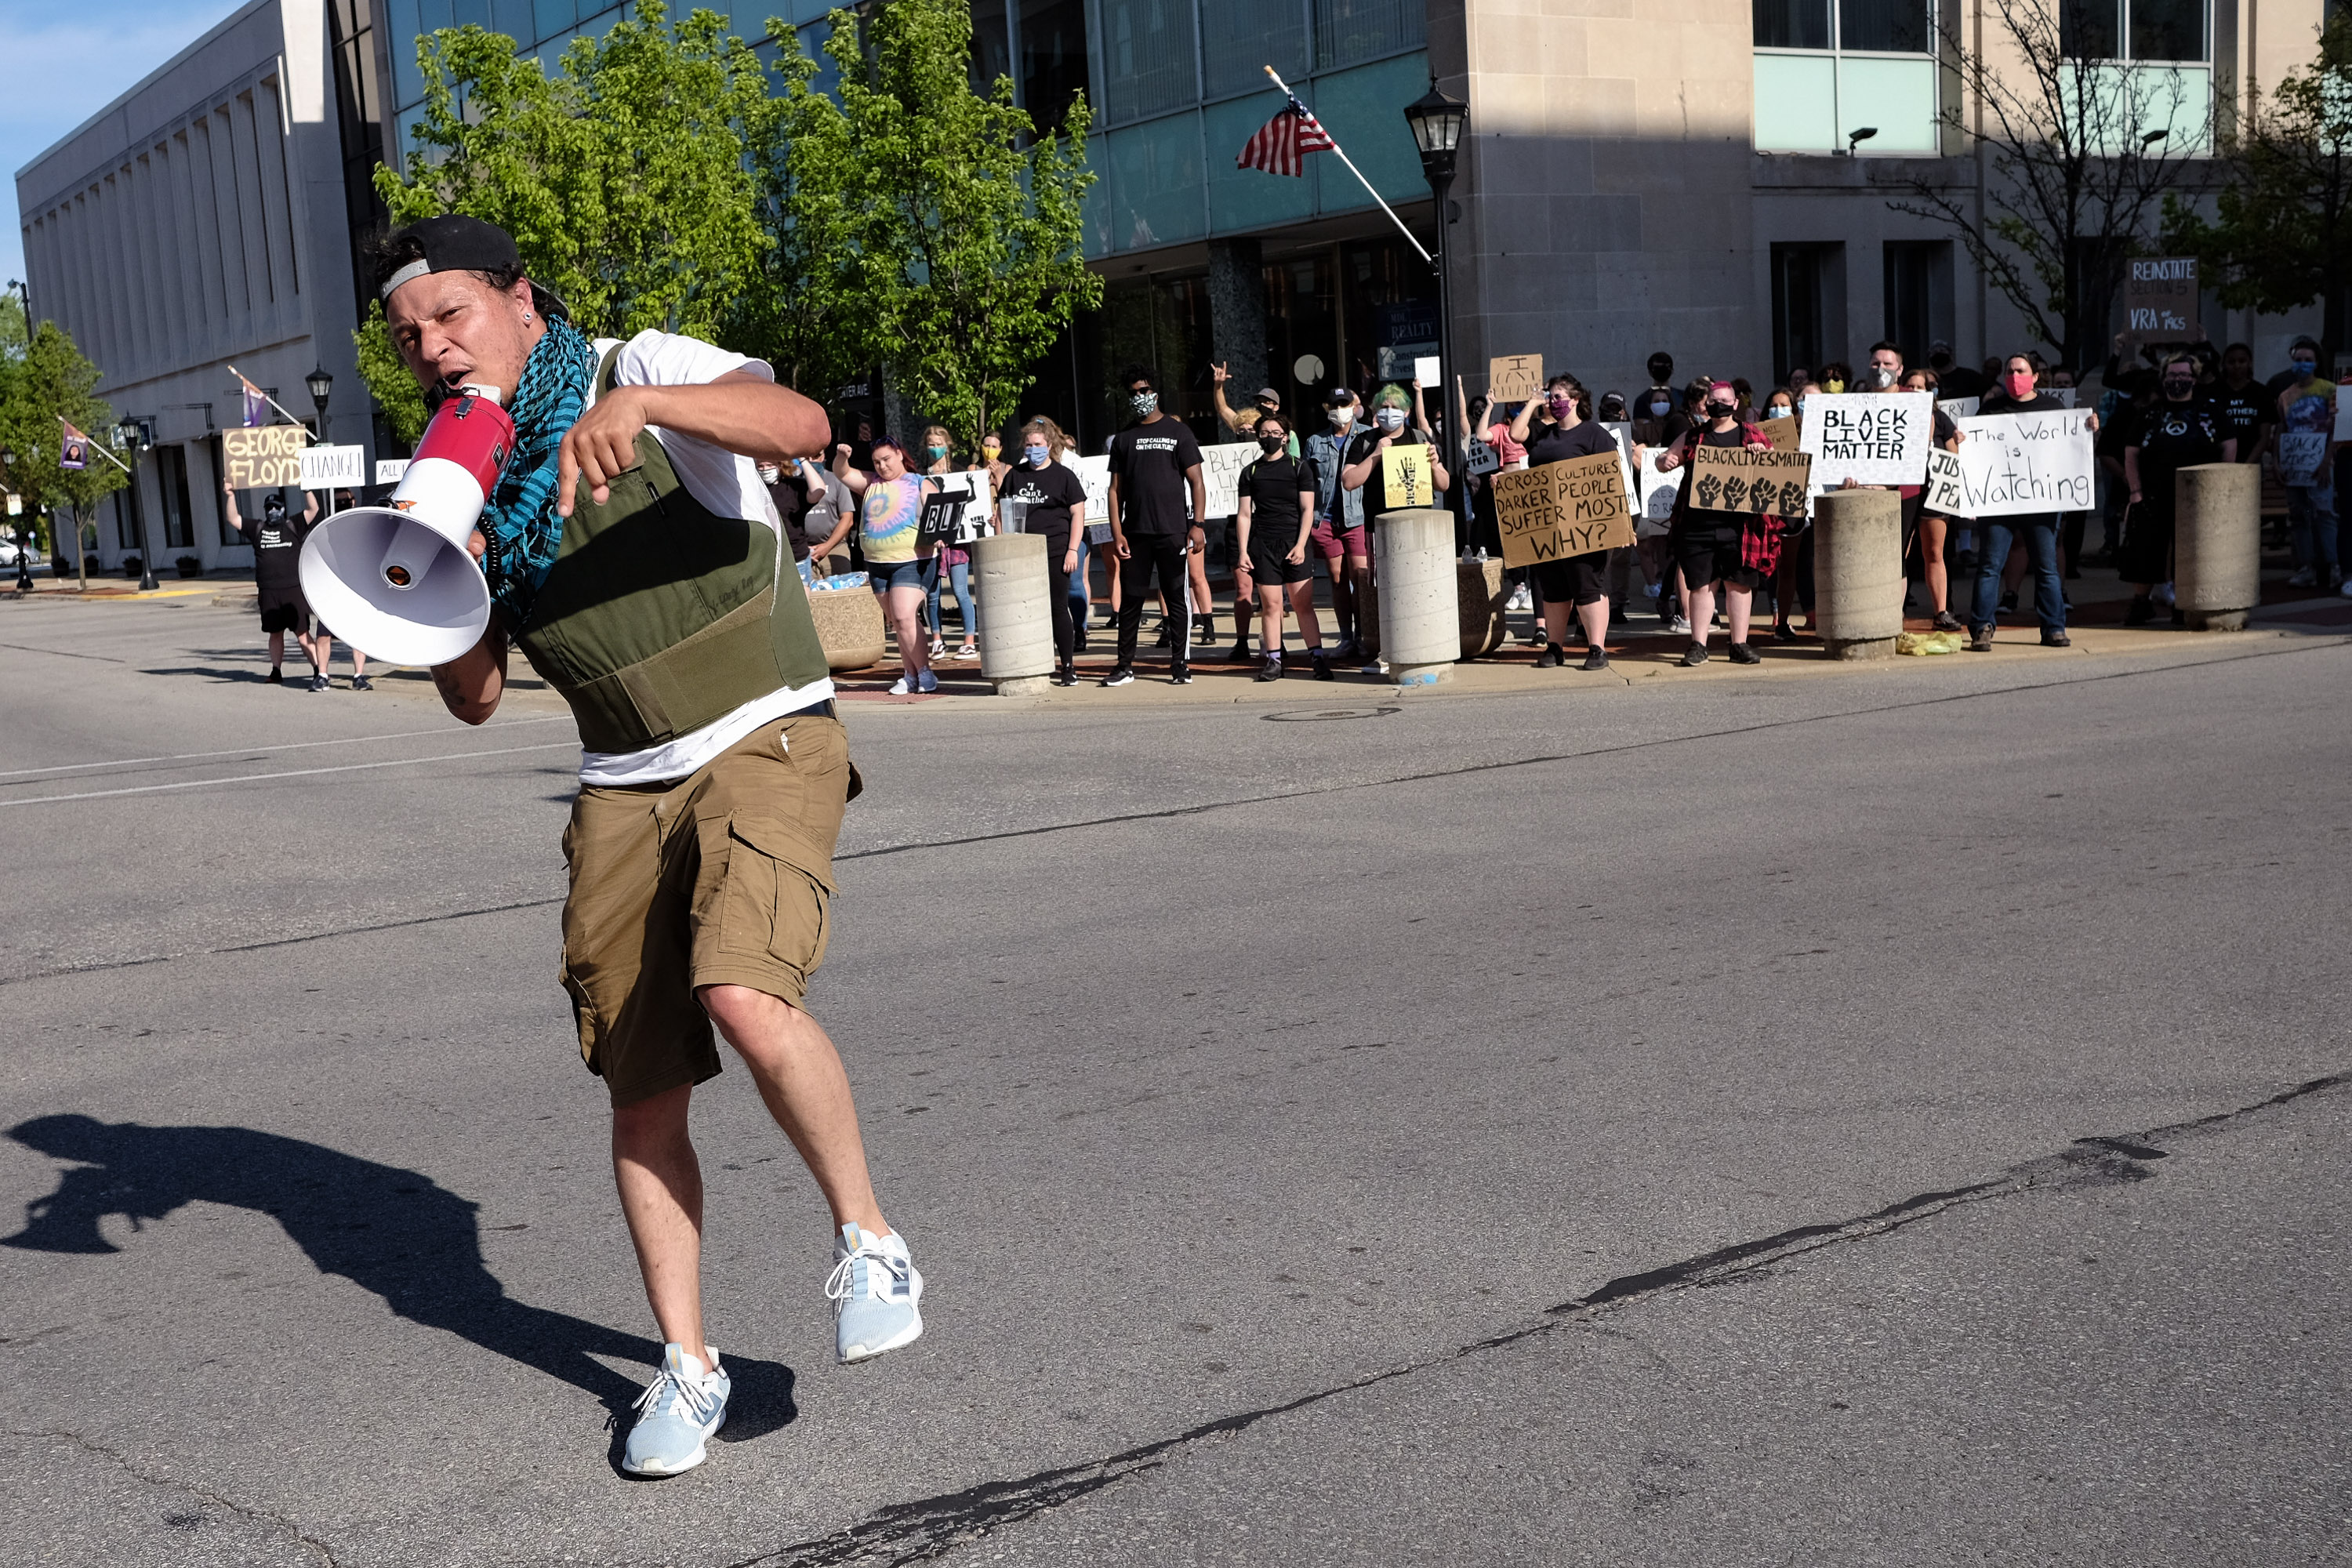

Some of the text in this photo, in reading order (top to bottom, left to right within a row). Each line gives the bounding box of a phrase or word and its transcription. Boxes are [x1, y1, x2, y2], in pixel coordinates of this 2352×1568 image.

[2133, 259, 2195, 281] REINSTATE
[1392, 321, 1434, 339] REALTY
[2130, 307, 2158, 330] VRA
[1824, 408, 1907, 428] BLACK
[1969, 416, 2078, 442] The World
[225, 427, 307, 457] GEORGE
[1823, 426, 1905, 443] LIVES
[1823, 442, 1904, 460] MATTER
[2005, 445, 2021, 457] is
[230, 458, 301, 487] FLOYD
[381, 464, 397, 477] ALL
[1961, 456, 2089, 507] Watching
[1018, 488, 1041, 497] Can't
[1495, 470, 1548, 495] ACROSS
[1496, 488, 1552, 514] DARKER
[1559, 477, 1616, 500] PEOPLE
[1501, 506, 1566, 535] SUFFER
[1530, 523, 1607, 560] WHY?
